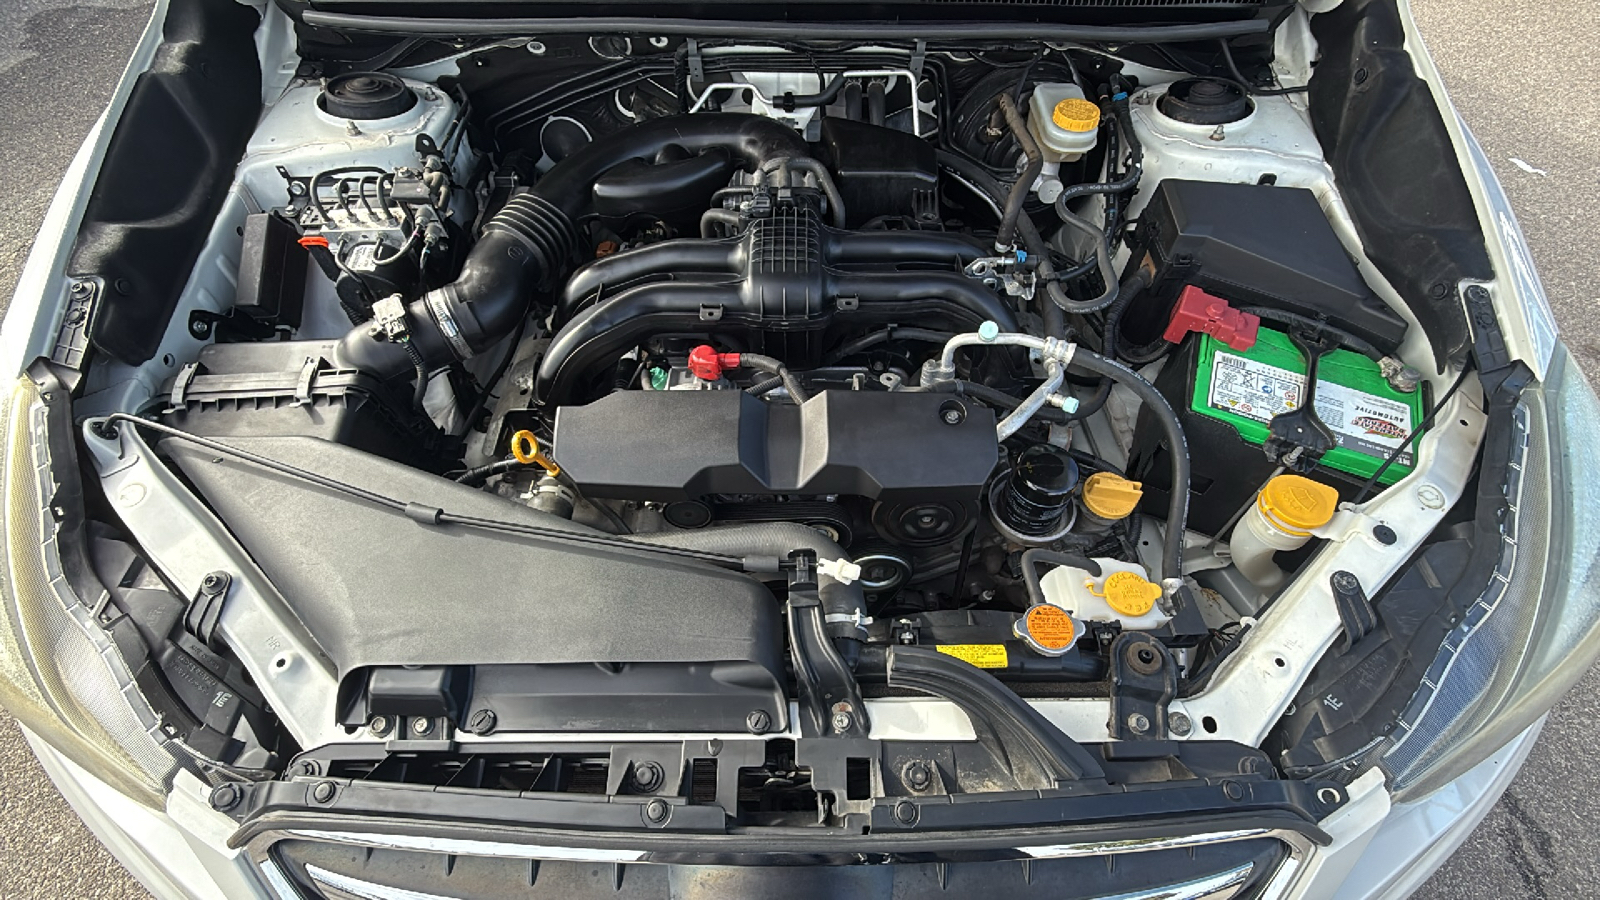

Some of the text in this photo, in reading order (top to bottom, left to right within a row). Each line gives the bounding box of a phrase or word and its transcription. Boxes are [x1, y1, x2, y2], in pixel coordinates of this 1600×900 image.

[1354, 405, 1404, 423] AUTOMOTIVE
[1351, 419, 1408, 439] INTERSTATE
[1355, 416, 1405, 434] BATTERIES
[1323, 693, 1344, 711] 1E
